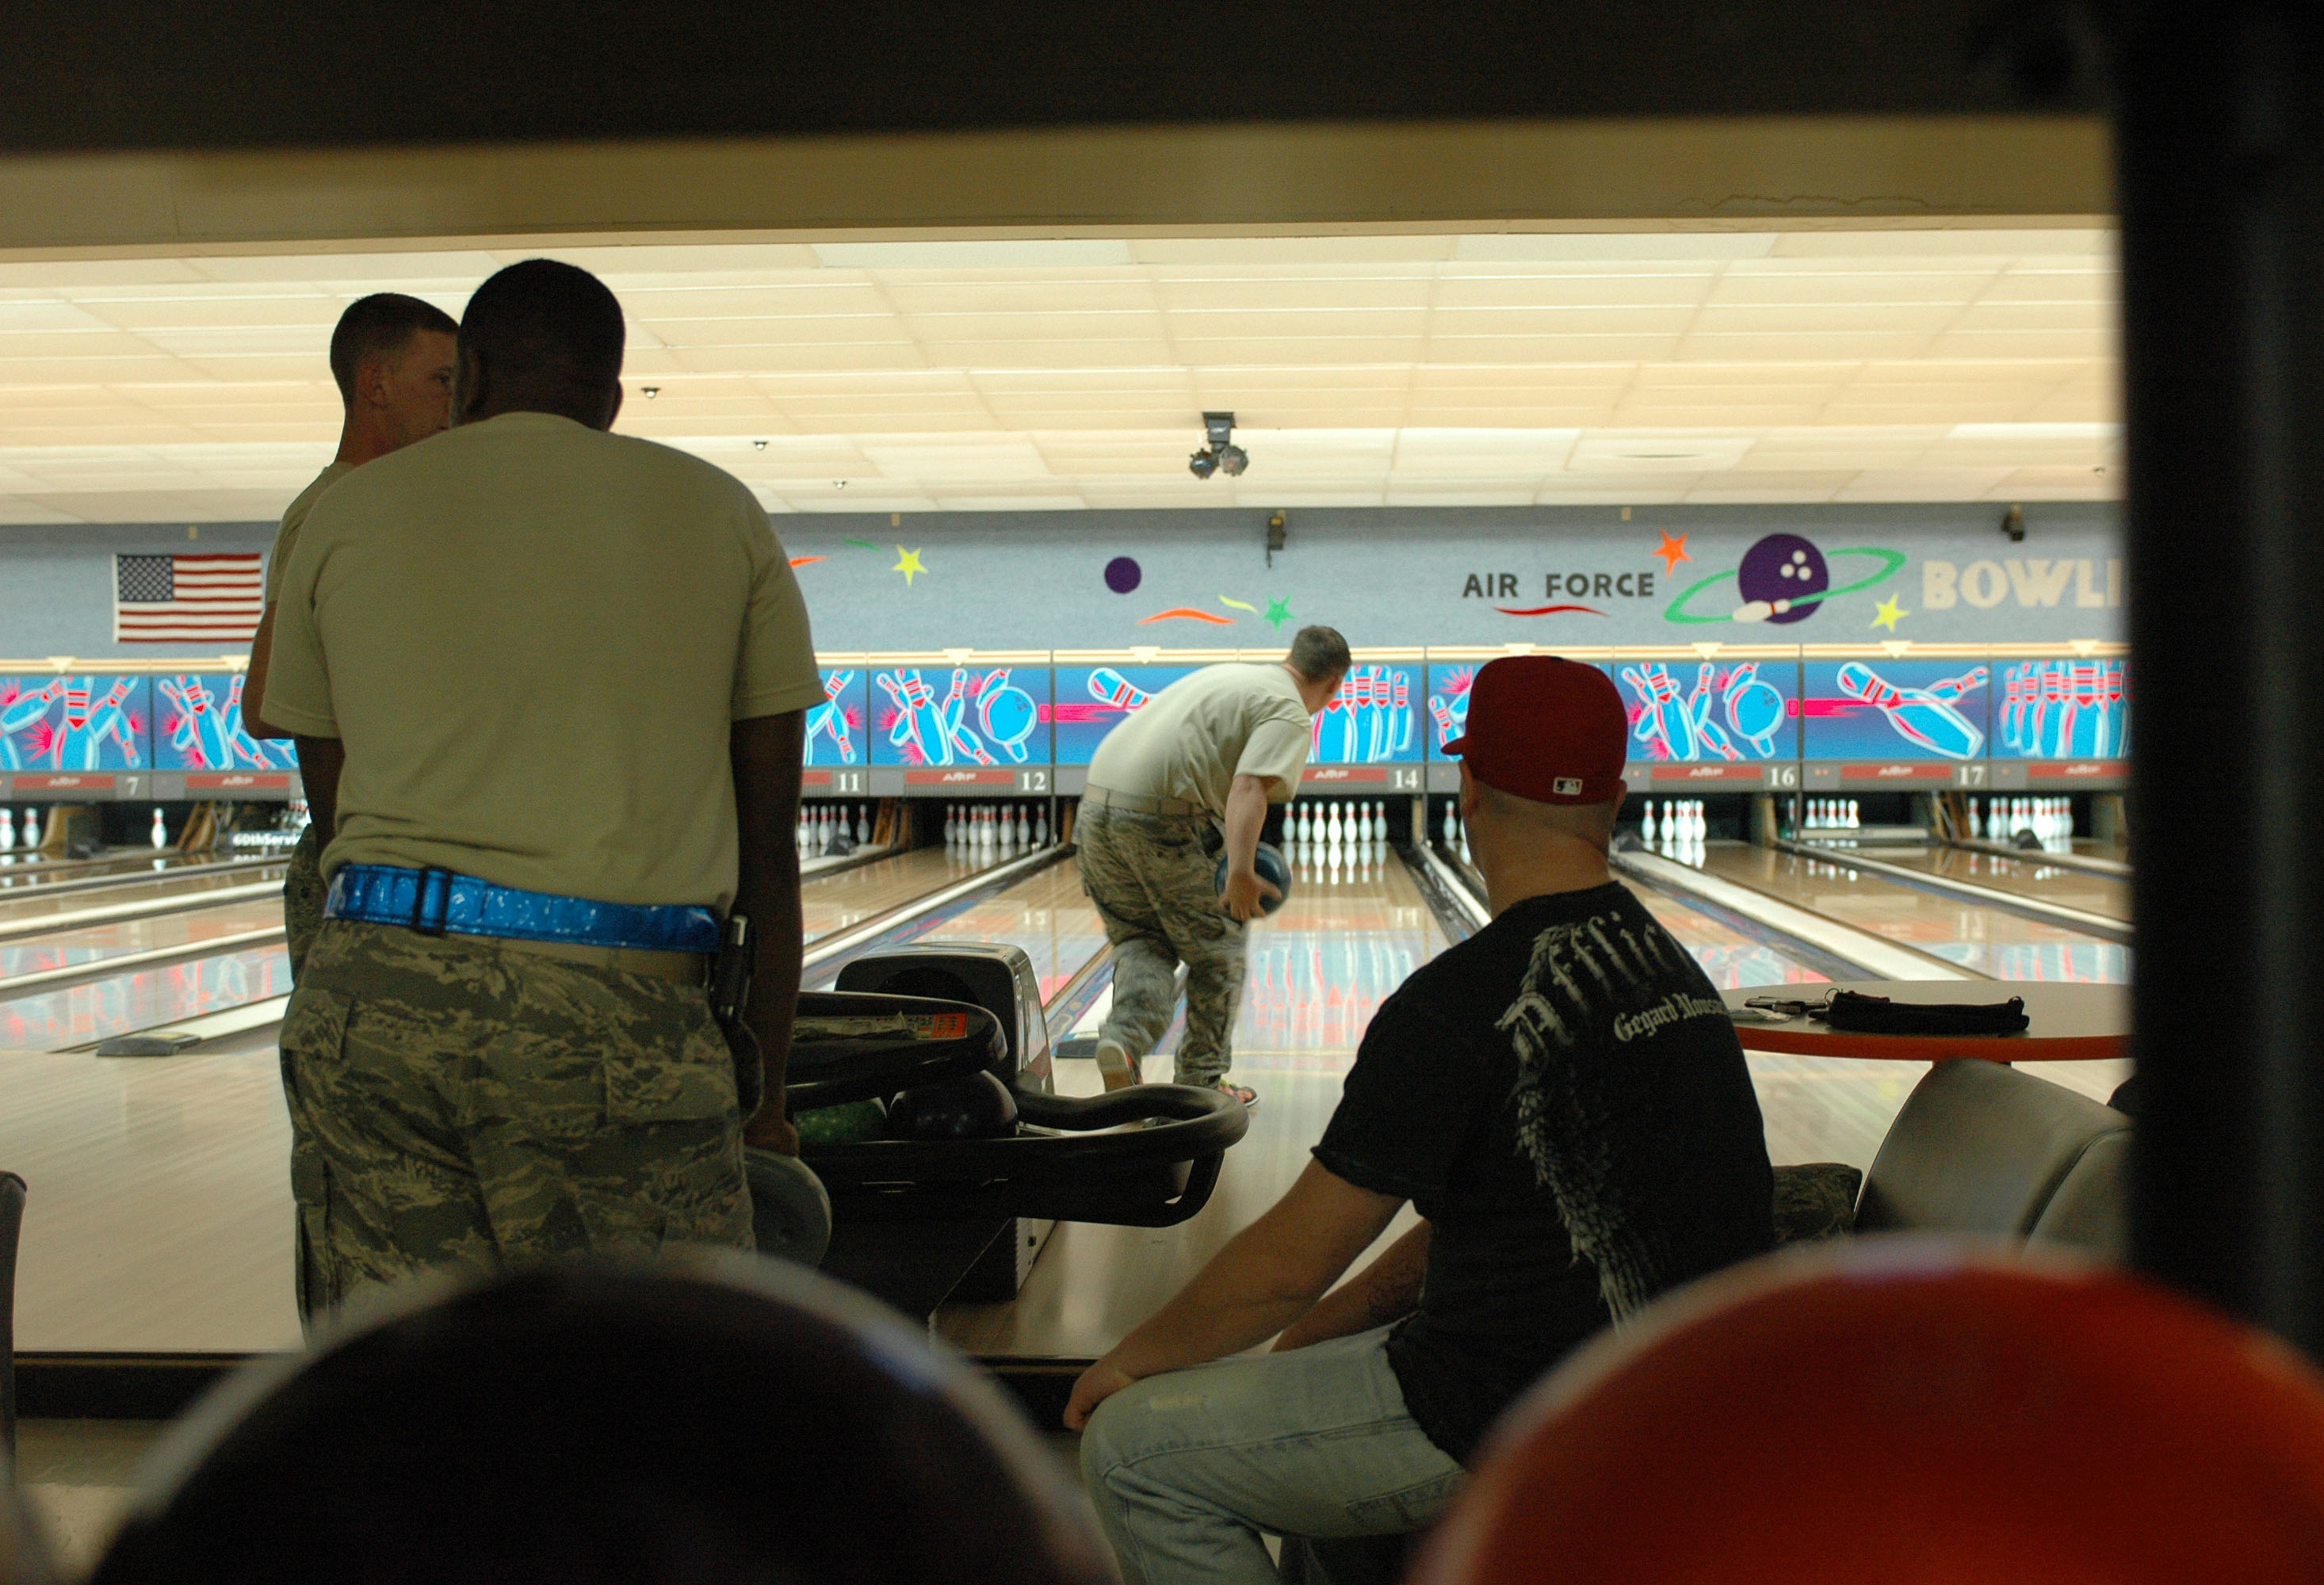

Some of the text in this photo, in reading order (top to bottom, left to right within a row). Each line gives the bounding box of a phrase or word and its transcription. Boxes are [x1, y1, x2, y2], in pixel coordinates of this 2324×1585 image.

[1462, 573, 1655, 598] AIR FORCE
[126, 776, 140, 796] 7
[838, 773, 860, 792] 11
[1022, 771, 1046, 791] 12
[1395, 769, 1419, 789] 14
[1771, 766, 1796, 787] 16
[1959, 766, 1985, 786] 17
